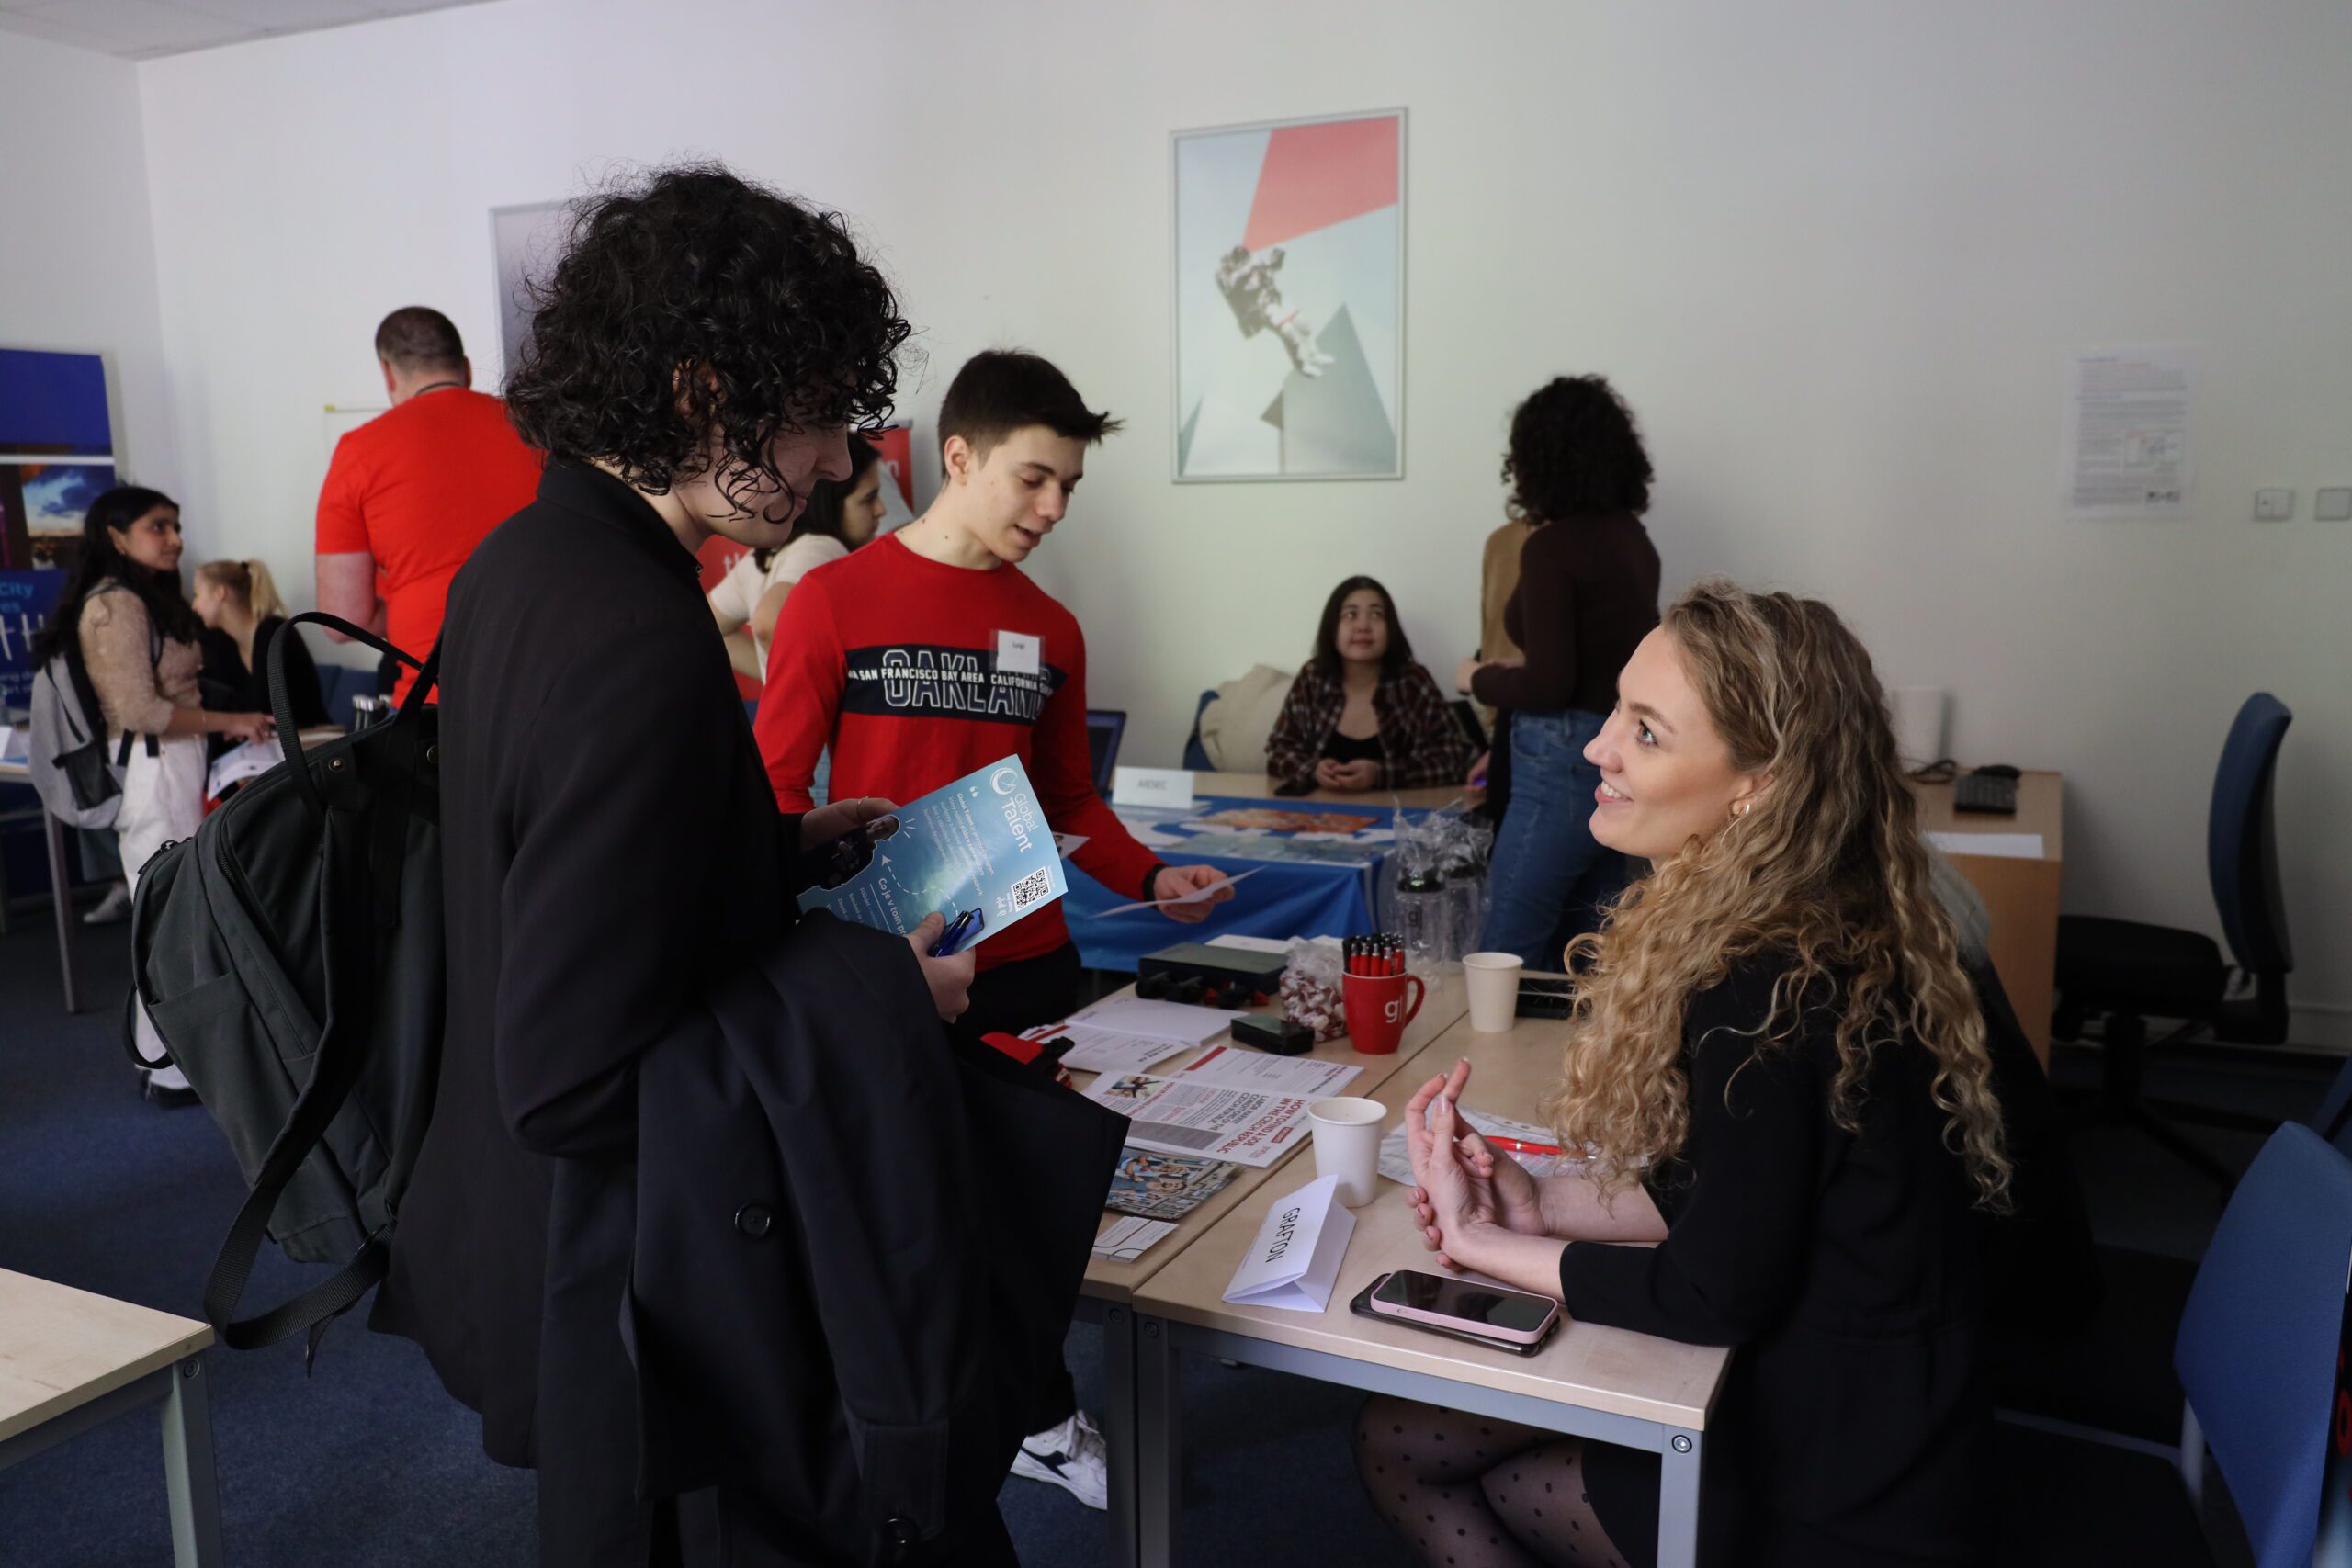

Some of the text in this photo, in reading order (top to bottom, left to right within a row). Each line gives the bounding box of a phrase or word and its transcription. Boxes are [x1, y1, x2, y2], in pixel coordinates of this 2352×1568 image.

[859, 670, 878, 681] SAN
[881, 668, 938, 680] FRANCISCO
[941, 670, 958, 682] BAY
[961, 672, 985, 683] AREA
[990, 673, 1038, 691] CALIFORNIA
[1014, 793, 1039, 832] Global
[1001, 797, 1033, 853] Talent
[878, 877, 888, 890] Co
[881, 889, 891, 900] je
[890, 906, 902, 924] tom
[1280, 1097, 1294, 1106] IN
[1284, 1099, 1306, 1116] HOW
[1267, 1105, 1285, 1117] THE
[1276, 1114, 1292, 1122] TO
[1247, 1115, 1273, 1133] CZECH
[1262, 1121, 1282, 1133] FIND
[1216, 1131, 1253, 1154] REPUBLIC
[1242, 1136, 1262, 1146] JOB
[1265, 1207, 1301, 1263] GRAFTON
